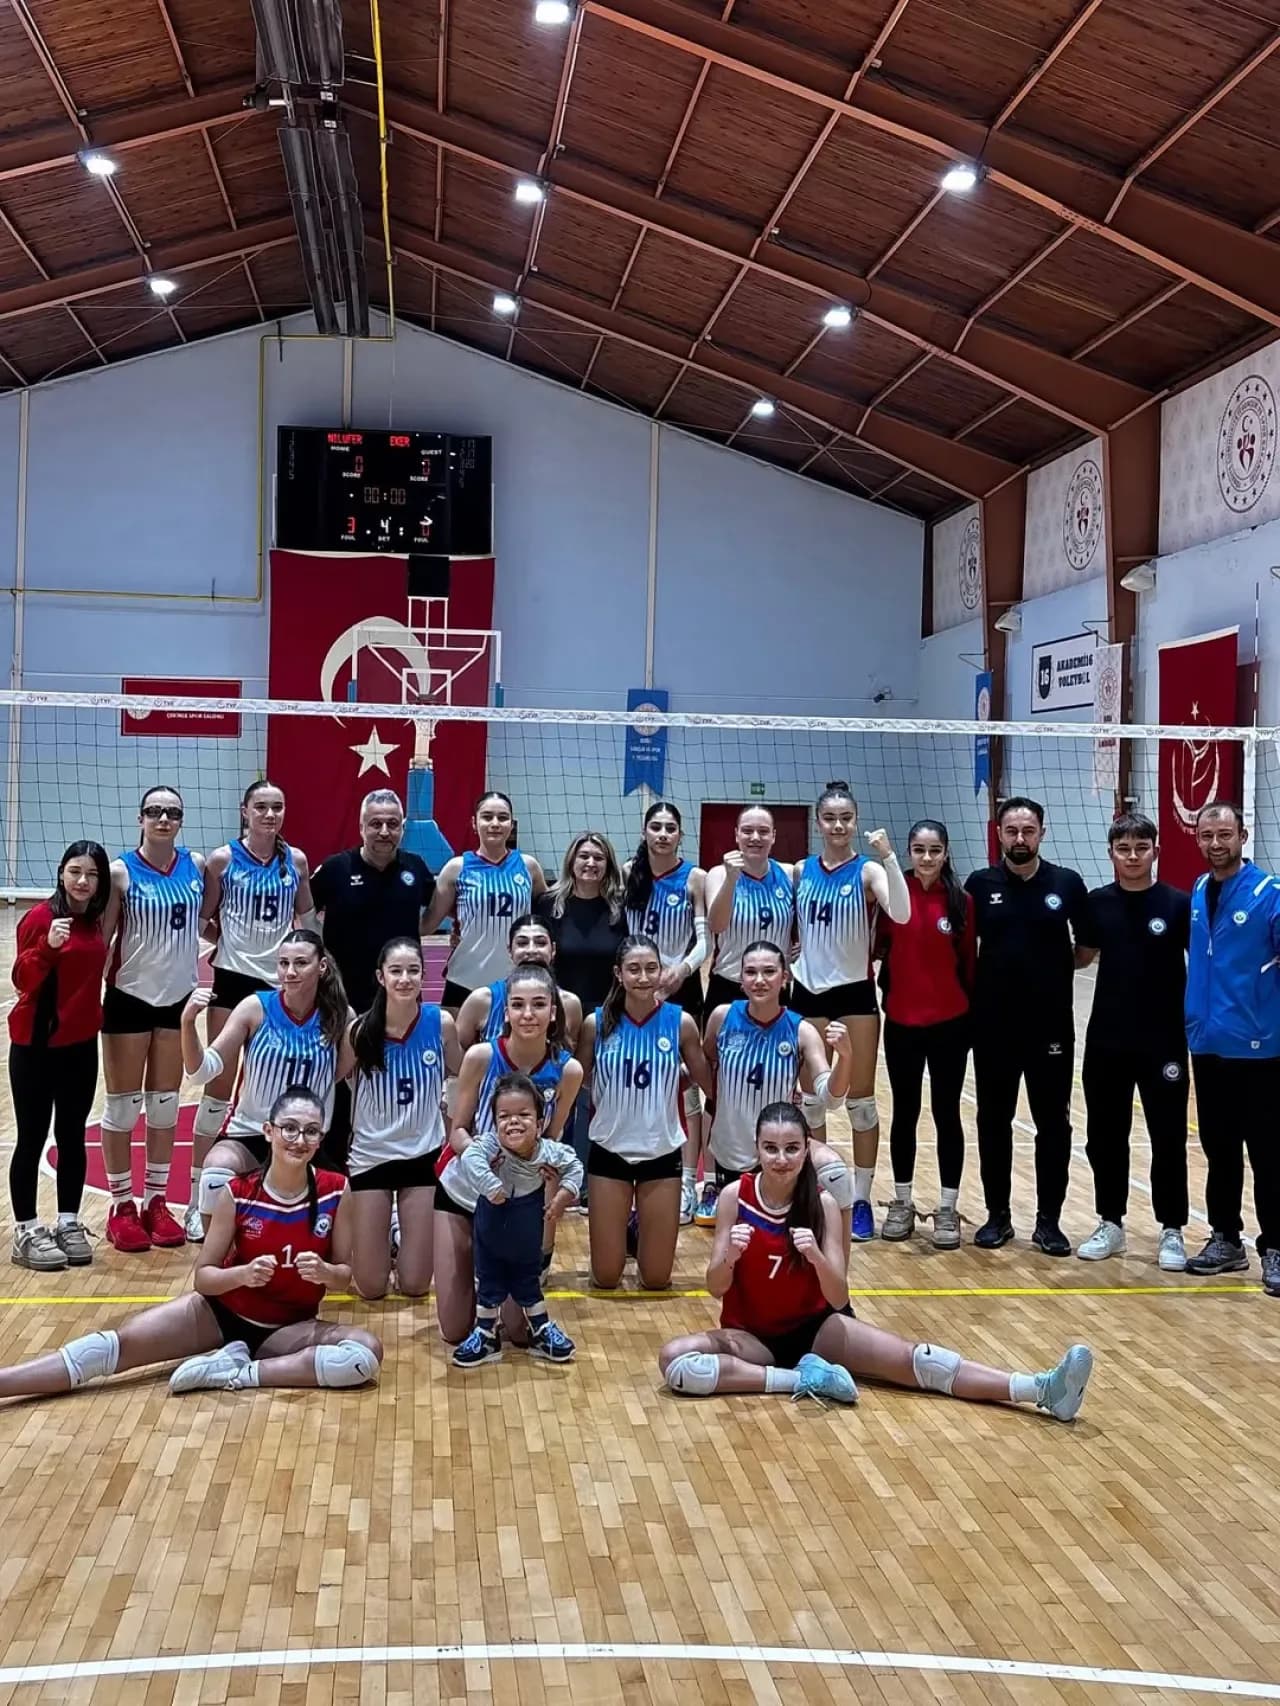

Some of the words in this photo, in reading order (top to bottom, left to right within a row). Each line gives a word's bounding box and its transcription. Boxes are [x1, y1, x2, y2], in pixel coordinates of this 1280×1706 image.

[347, 516, 356, 534] 3
[169, 902, 187, 930] 8
[254, 894, 279, 922] 15
[487, 891, 513, 917] 12
[809, 900, 833, 927] 14
[758, 906, 773, 930] 9
[286, 1057, 313, 1088] 11
[623, 1058, 651, 1090] 16
[747, 1062, 764, 1091] 4
[397, 1077, 414, 1105] 5
[281, 1244, 295, 1268] 1
[767, 1254, 783, 1280] 7
